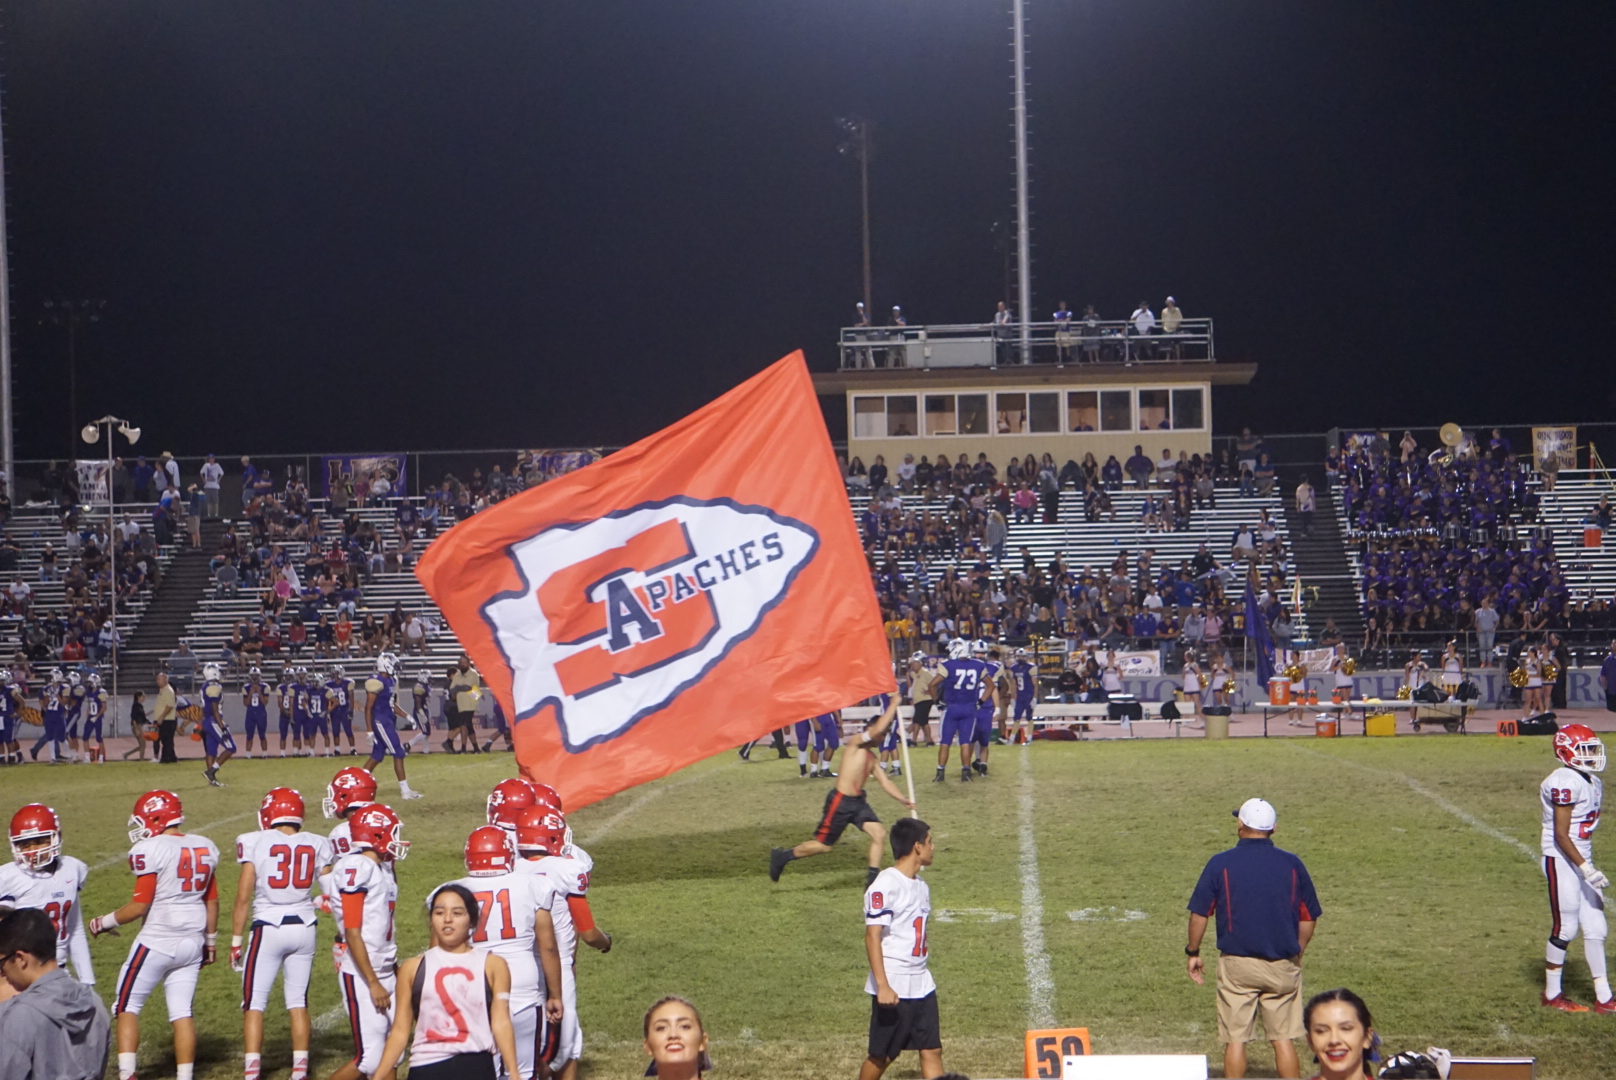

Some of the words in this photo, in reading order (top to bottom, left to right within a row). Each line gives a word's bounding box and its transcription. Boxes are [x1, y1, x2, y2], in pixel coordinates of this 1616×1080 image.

[605, 531, 785, 653] APACHES
[953, 669, 978, 690] 73
[310, 699, 322, 714] 31
[1499, 722, 1516, 736] 40
[1550, 788, 1572, 803] 23
[331, 837, 350, 855] 19
[177, 846, 211, 892] 45
[267, 843, 316, 890] 30
[345, 868, 358, 887] 7
[472, 888, 517, 943] 71
[426, 966, 475, 1044] S
